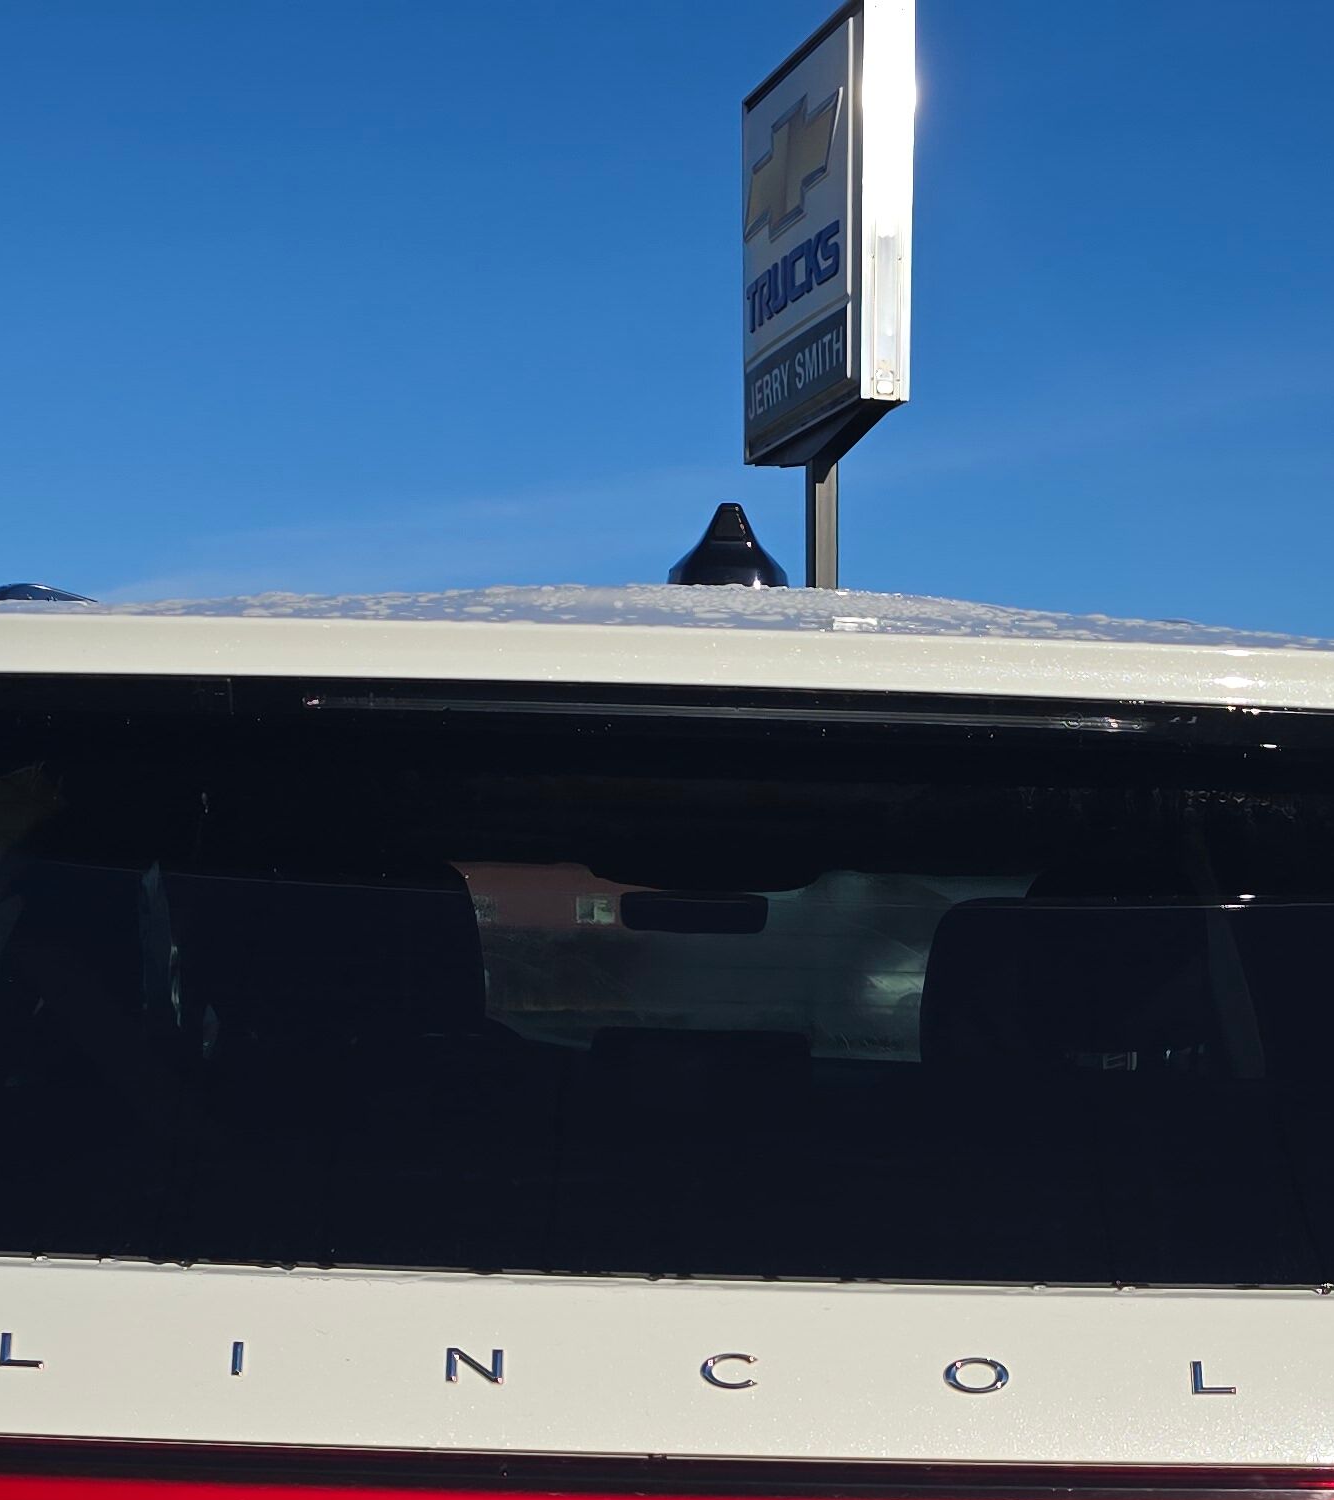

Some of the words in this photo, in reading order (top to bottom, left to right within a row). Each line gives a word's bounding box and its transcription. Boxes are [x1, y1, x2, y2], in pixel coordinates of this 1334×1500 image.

[746, 219, 840, 334] TRUCKS
[748, 360, 790, 420] JERRY
[795, 325, 844, 390] SMITH
